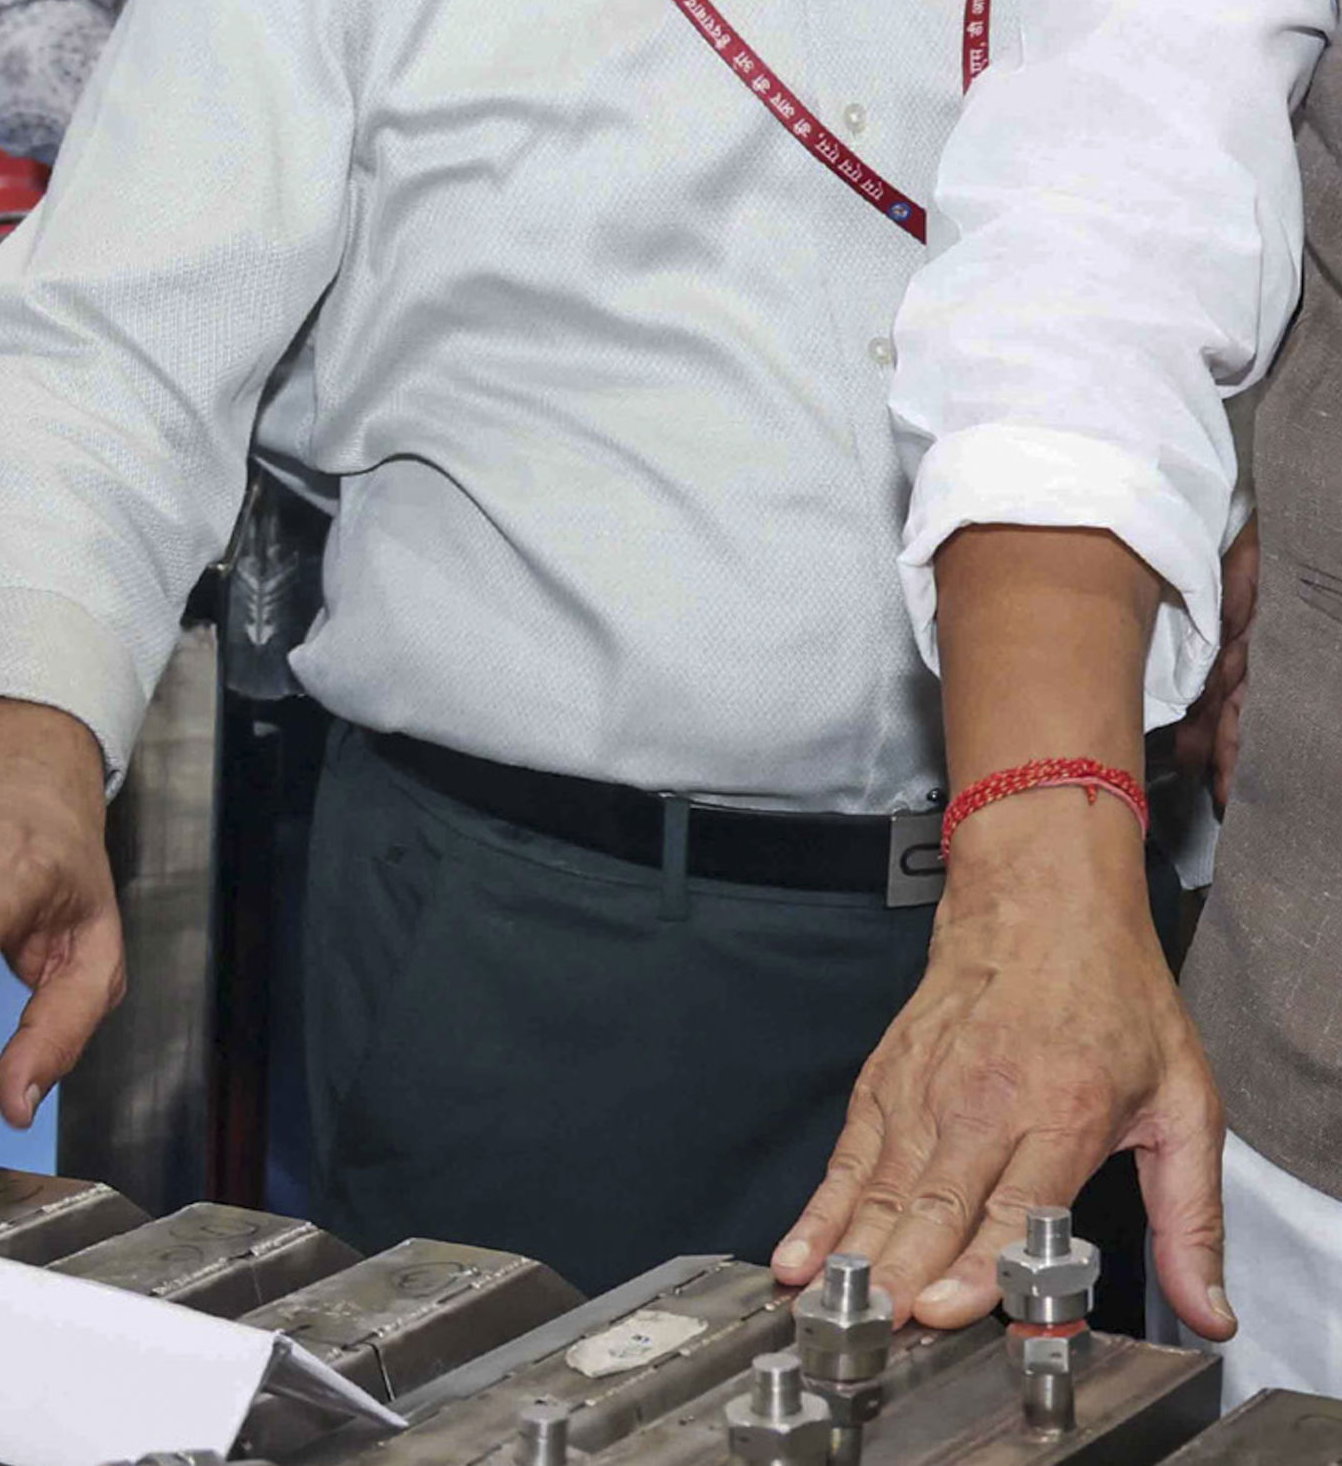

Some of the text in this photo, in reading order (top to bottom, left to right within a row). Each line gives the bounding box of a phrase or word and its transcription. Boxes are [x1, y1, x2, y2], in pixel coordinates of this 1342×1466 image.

[732, 51, 754, 74] ओ
[752, 74, 771, 94] डी
[769, 92, 795, 119] आर
[793, 118, 812, 138] डी
[814, 132, 840, 164] एस,
[837, 158, 863, 183] एस
[859, 179, 884, 201] एम
